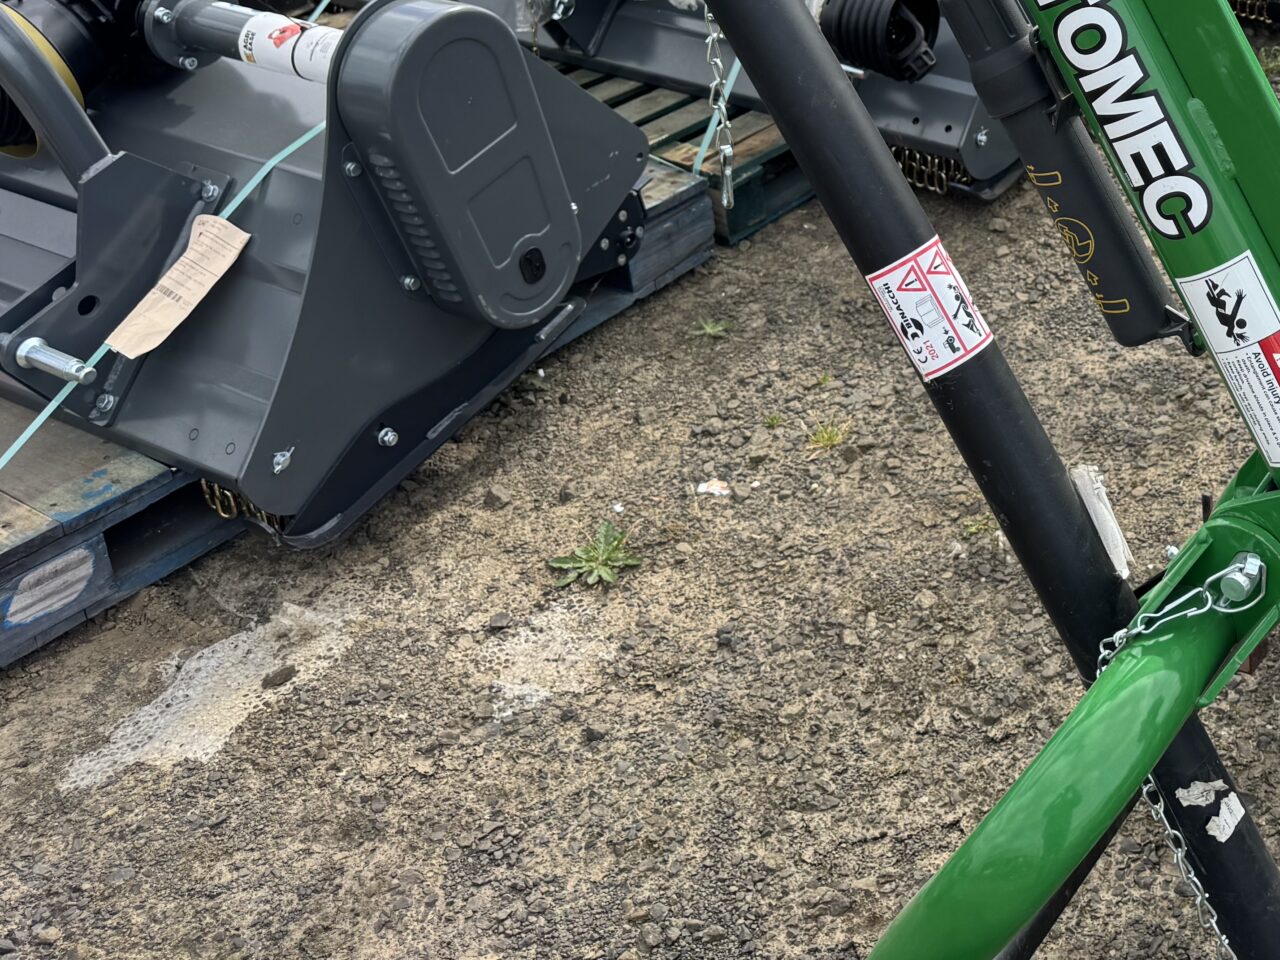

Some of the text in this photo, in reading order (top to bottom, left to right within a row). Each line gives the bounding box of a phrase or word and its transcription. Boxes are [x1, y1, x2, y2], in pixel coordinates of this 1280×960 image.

[882, 281, 912, 330] BINACCHI
[922, 339, 938, 360] 2021
[1250, 349, 1270, 378] Avoid
[1245, 355, 1265, 390] Entanglement
[1261, 389, 1270, 400] can
[1266, 400, 1277, 415] cause
